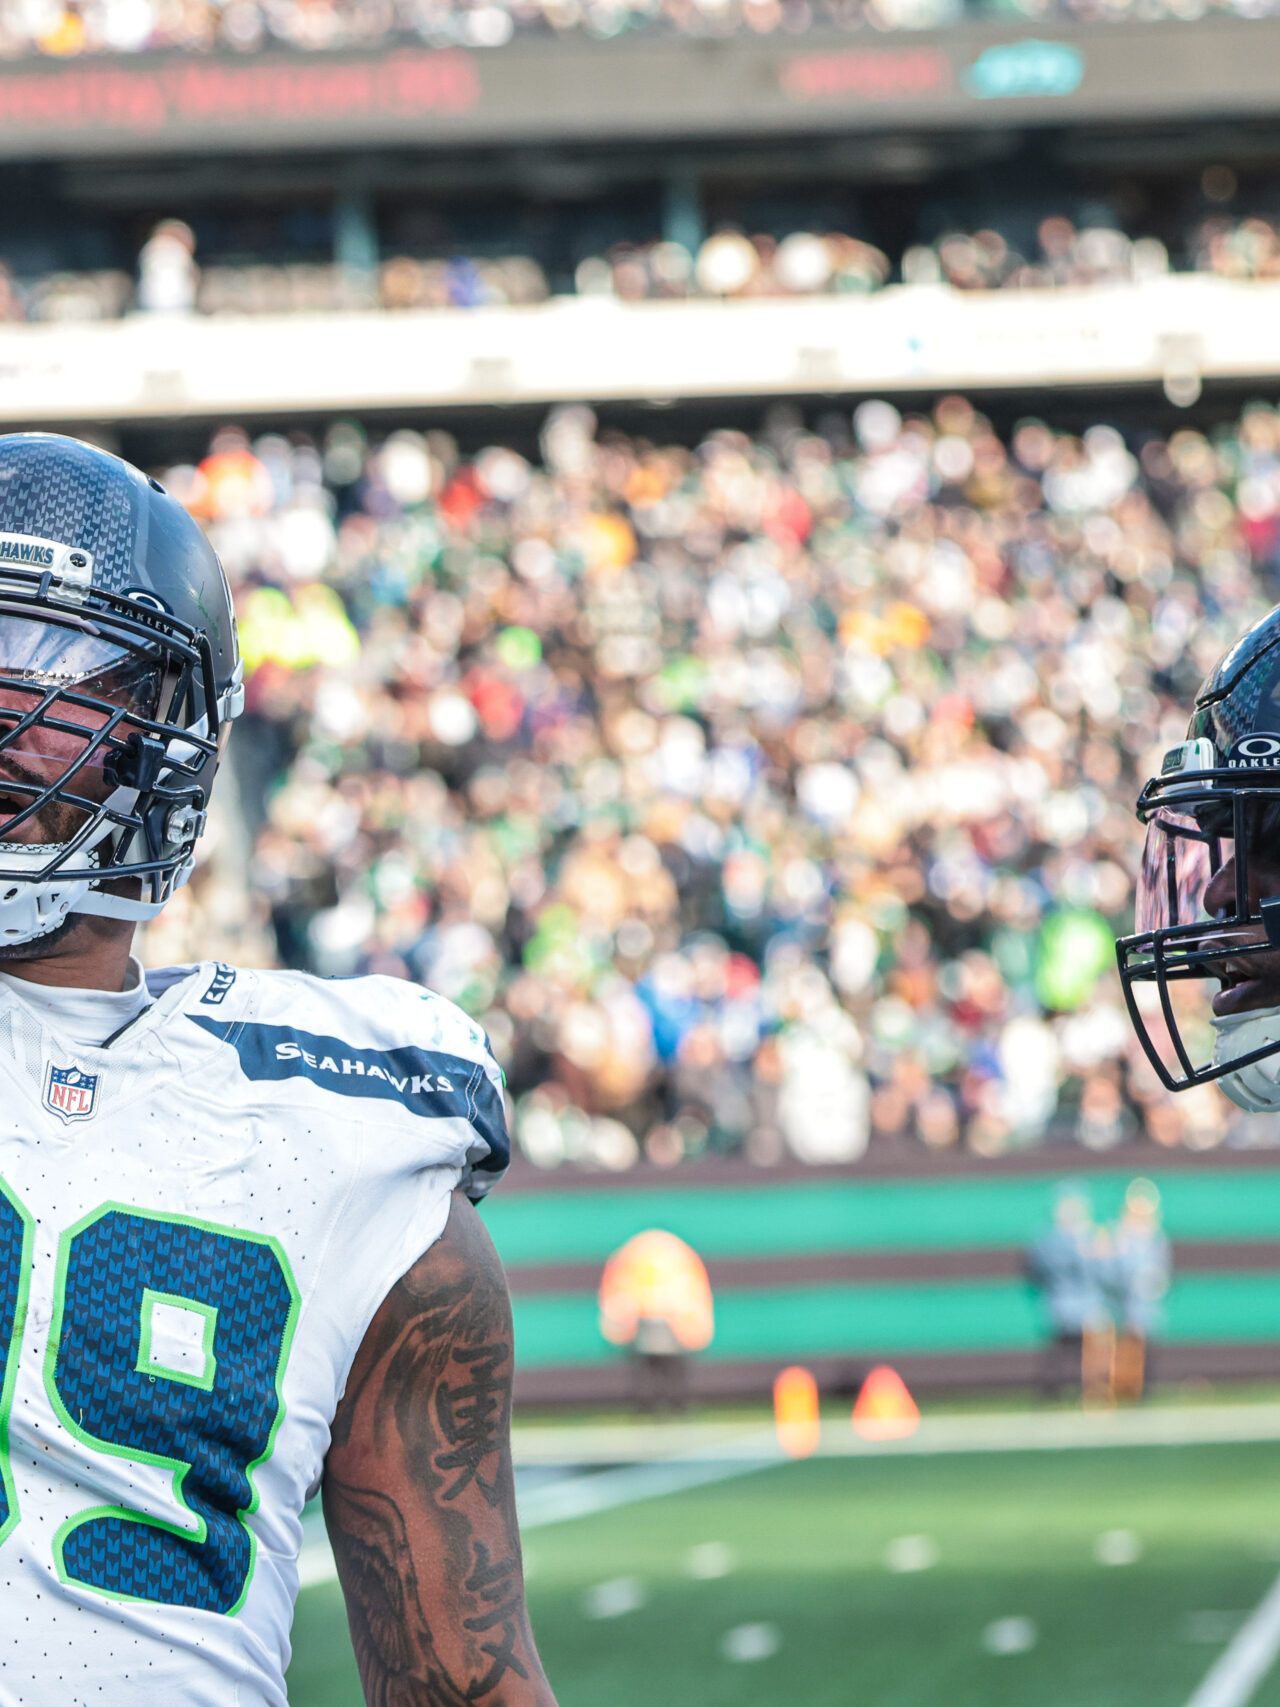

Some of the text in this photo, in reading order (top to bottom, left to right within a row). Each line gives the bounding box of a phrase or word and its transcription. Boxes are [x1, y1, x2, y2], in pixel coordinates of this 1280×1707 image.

[1228, 757, 1280, 769] OAKLE
[275, 1042, 455, 1094] SEAHAWKS
[51, 1083, 90, 1113] NFL
